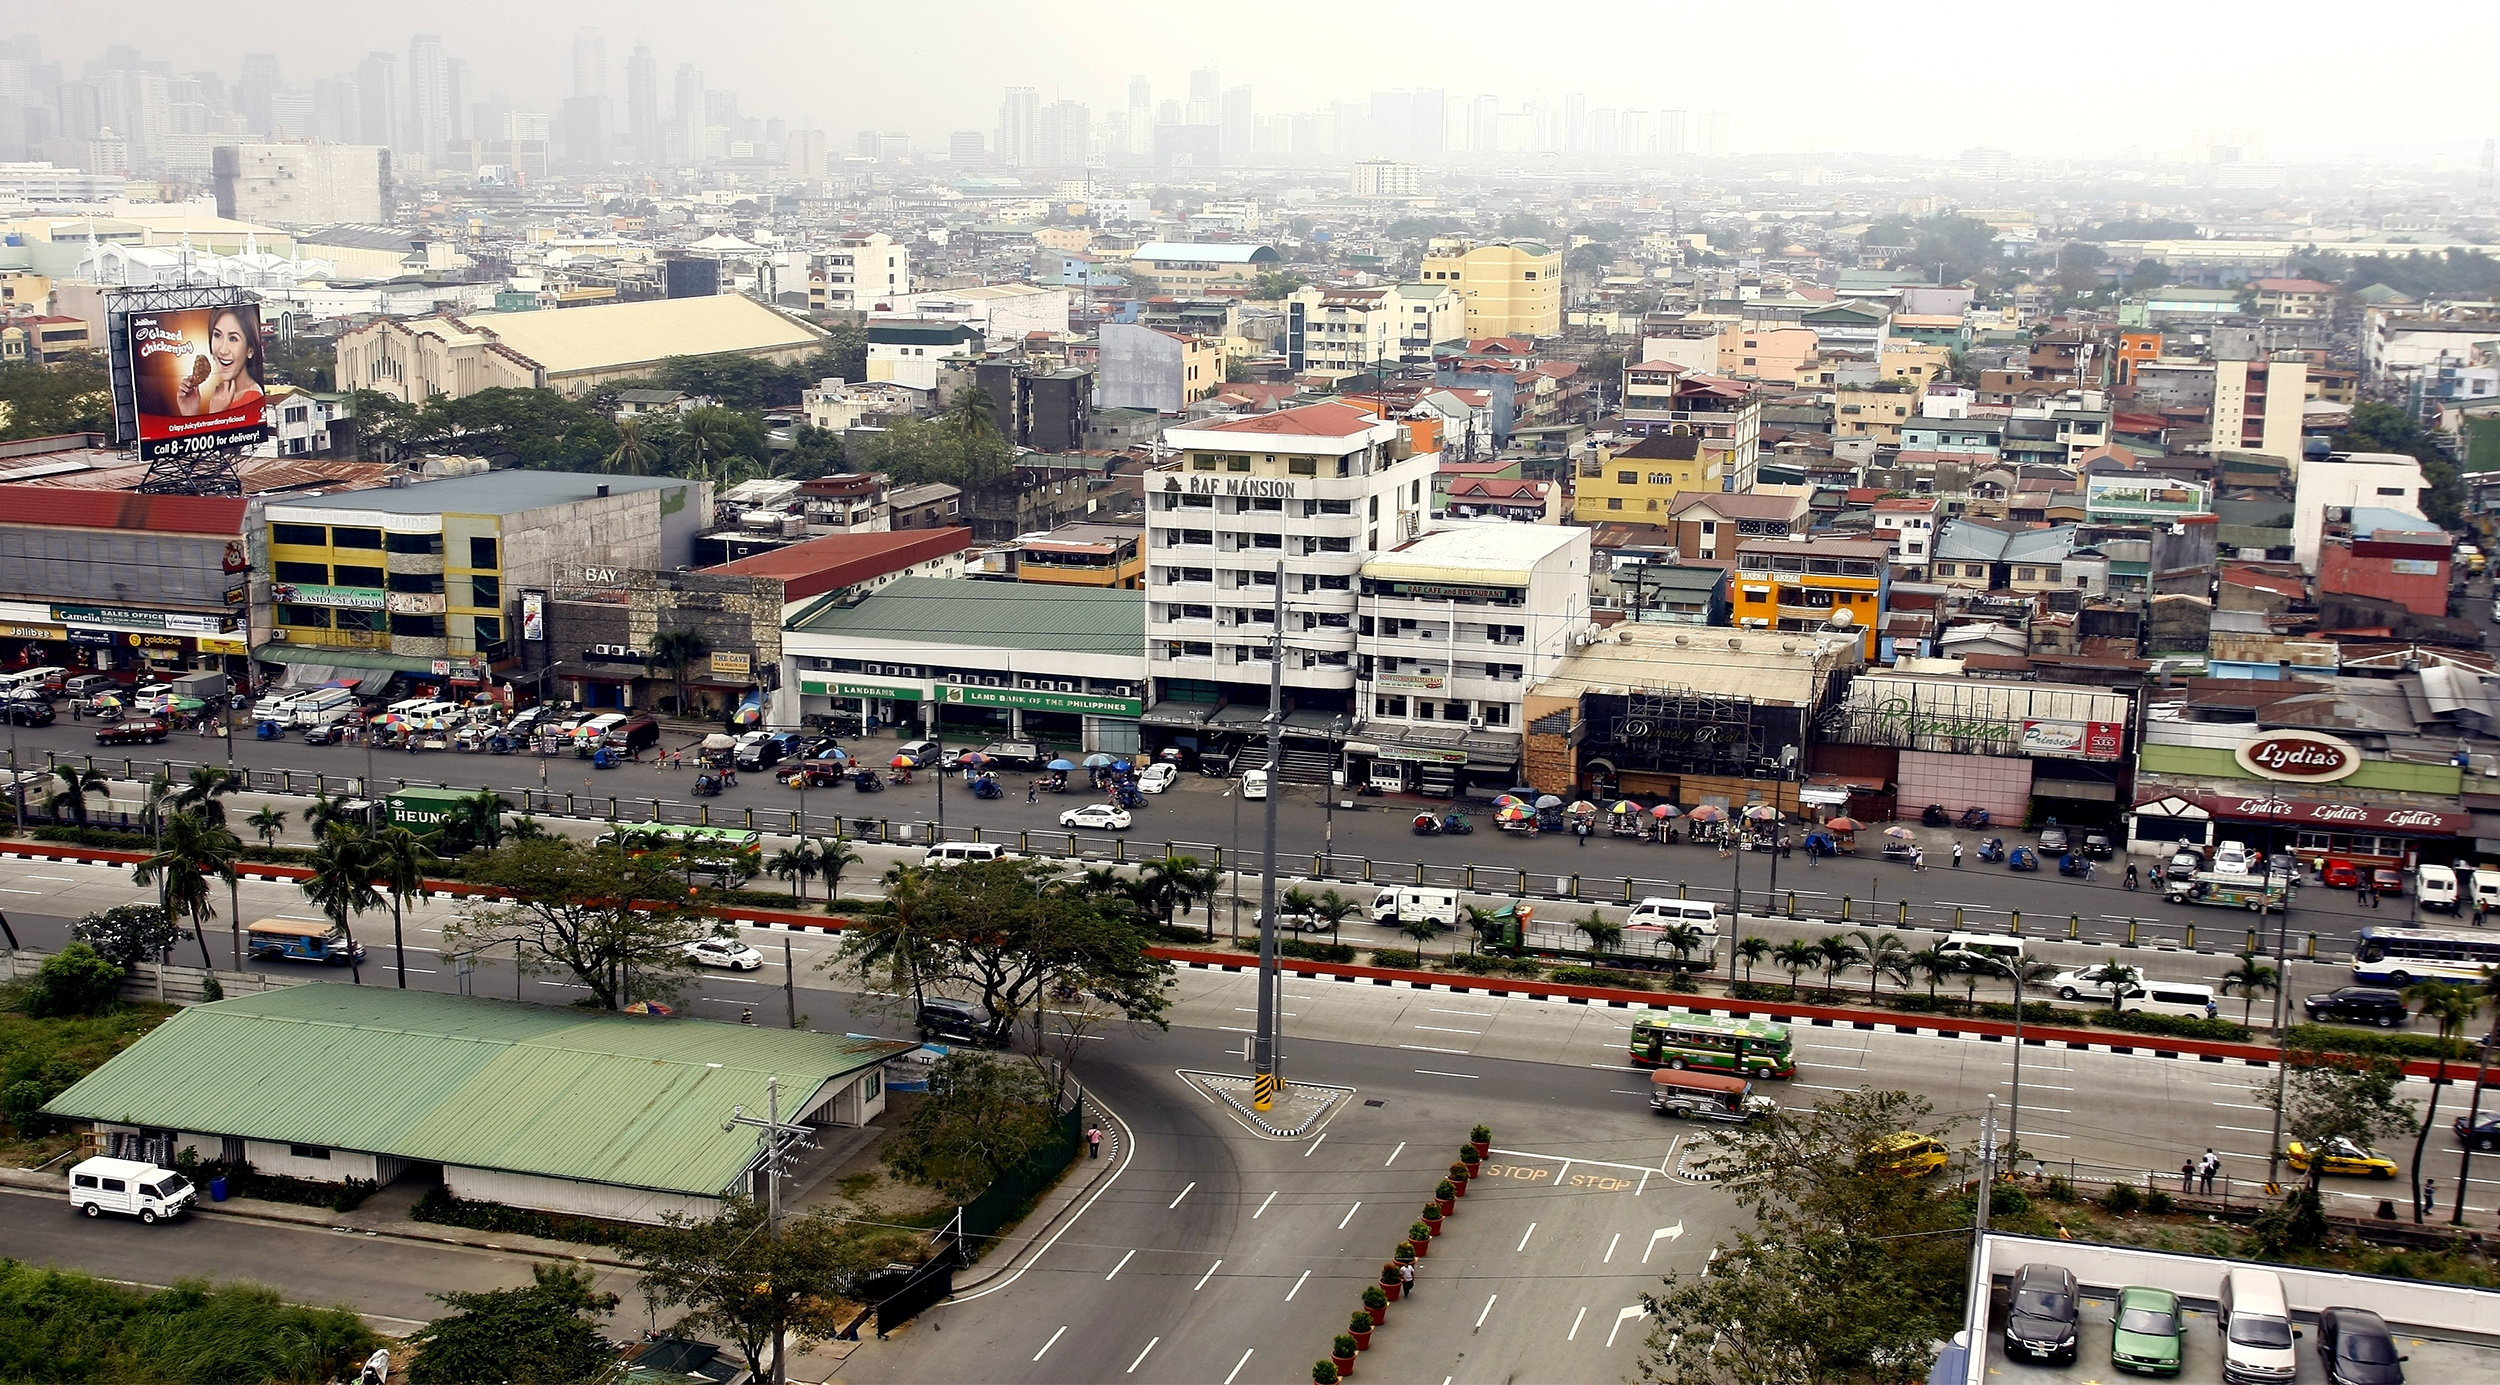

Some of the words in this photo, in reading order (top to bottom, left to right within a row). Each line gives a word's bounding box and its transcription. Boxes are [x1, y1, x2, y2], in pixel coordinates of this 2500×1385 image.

[134, 318, 158, 326] Jollibee
[148, 328, 183, 341] Glazed
[154, 443, 170, 455] Call
[170, 434, 215, 455] 8-7000
[216, 435, 227, 446] for
[228, 430, 260, 444] delivery!
[1190, 477, 1220, 494] RAF
[1226, 478, 1295, 498] MANSION
[586, 568, 618, 583] BAY
[1407, 585, 1421, 593] RAF
[1424, 586, 1441, 594] CAFE
[1459, 589, 1503, 598] RESTAURANT
[337, 599, 383, 608] SEAFOOD
[101, 610, 130, 618] SALES
[132, 612, 164, 620] OFFICE
[10, 627, 51, 638] Jollibee
[844, 686, 895, 697] LANDBANK
[971, 692, 996, 701] LAND
[999, 695, 1025, 704] BANK
[1045, 698, 1063, 707] THE
[1066, 700, 1127, 711] PHILIPPINES
[1878, 698, 2010, 738] Prinsesa
[1626, 720, 1691, 743] Dynasty
[1693, 725, 1740, 744] Real
[2024, 728, 2081, 747] Prinsesa
[2256, 743, 2340, 768] Lydia's
[2236, 798, 2293, 815] Lydia's
[2310, 804, 2368, 821] Lydia's
[2384, 810, 2442, 827] Lydia's
[1487, 1164, 1548, 1181] STOP
[1569, 1174, 1633, 1191] STOP
